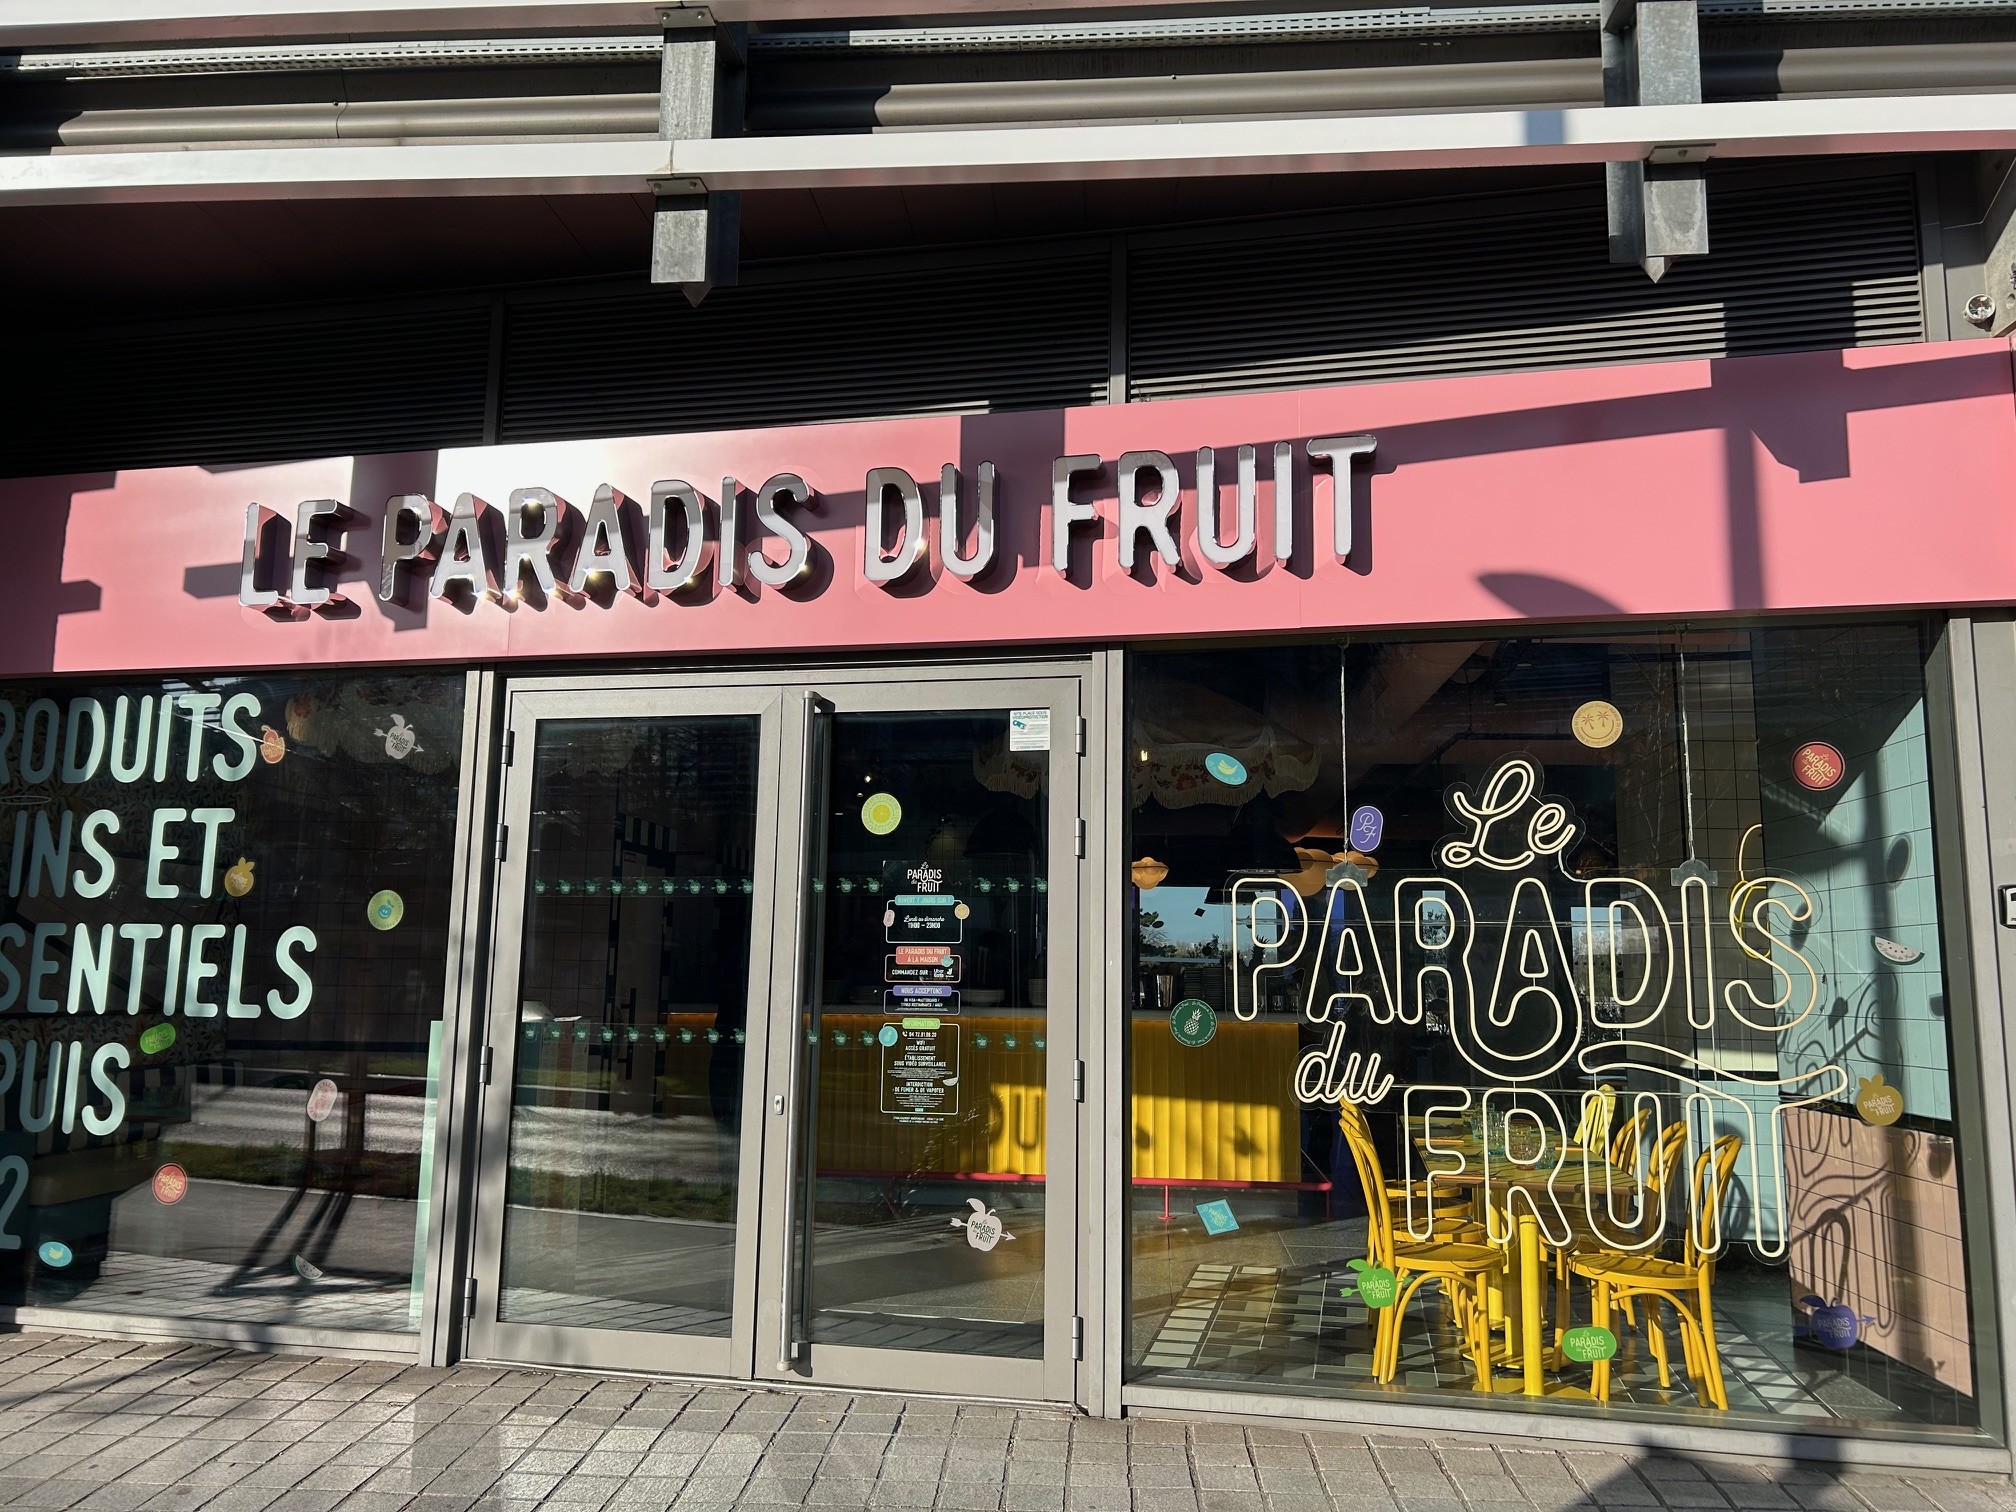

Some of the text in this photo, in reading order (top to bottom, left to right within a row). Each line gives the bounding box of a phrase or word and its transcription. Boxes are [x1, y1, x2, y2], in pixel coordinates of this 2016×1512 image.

[239, 434, 1378, 607] LE PARADIS DU FRUIT
[1801, 748, 1837, 777] PARADIS
[1801, 764, 1830, 786] FRUIT
[1441, 759, 1575, 870] Le
[8, 807, 235, 899] INS ET
[907, 869, 942, 883] PARADIS
[917, 880, 943, 893] FRUIT
[1231, 876, 1819, 1082] PARADIS
[1294, 1021, 1394, 1105] du
[1863, 1095, 1892, 1109] PARADIS
[1875, 1103, 1895, 1116] FRUIT
[1404, 1040, 1847, 1257] FRUIT
[158, 1172, 183, 1190] PARADIS
[160, 1185, 180, 1199] FRUIT
[970, 1221, 996, 1235] PARADIS
[975, 1231, 994, 1244] FRUIT
[1362, 1279, 1391, 1291] PARADIS
[1371, 1287, 1391, 1299] FRUIT
[1818, 1317, 1850, 1330] PARADIS
[1830, 1326, 1852, 1339] FRUIT
[1569, 1335, 1605, 1350] PARADIS
[1582, 1345, 1607, 1359] FRUIT
